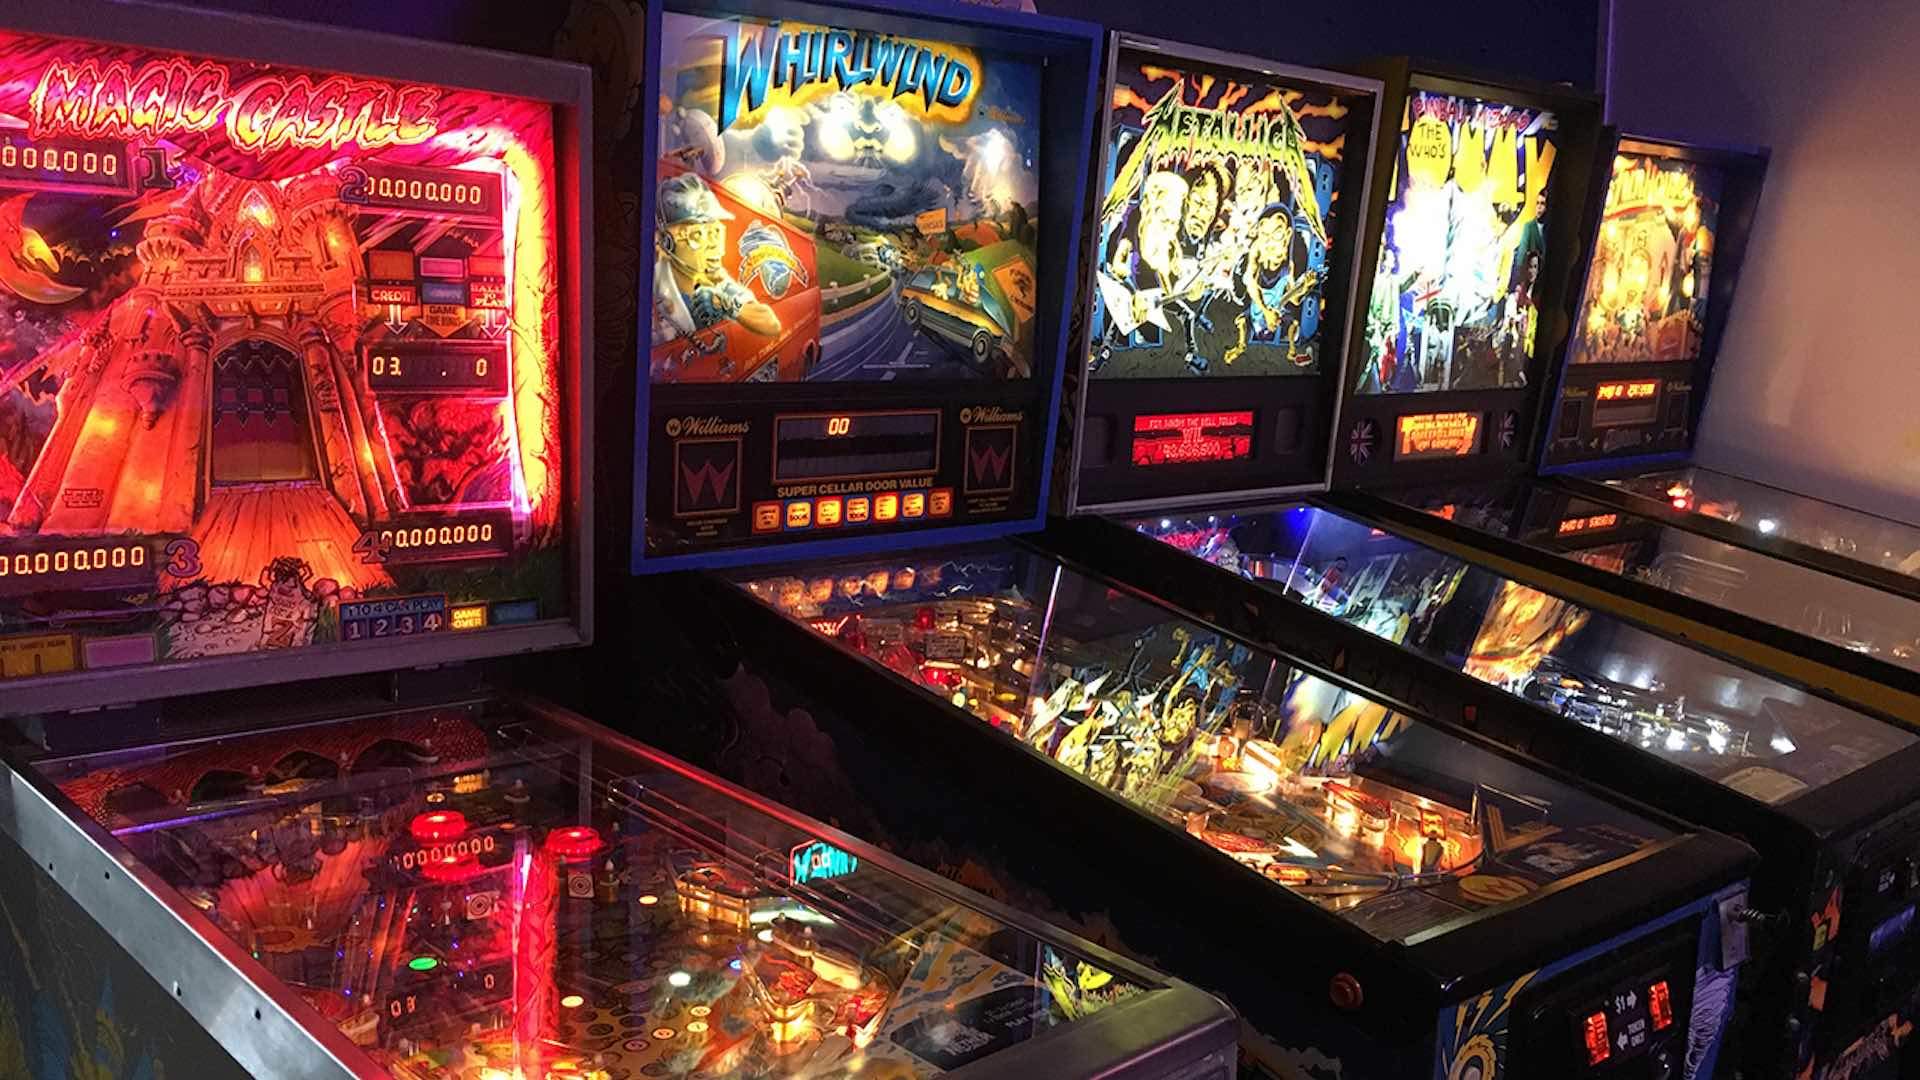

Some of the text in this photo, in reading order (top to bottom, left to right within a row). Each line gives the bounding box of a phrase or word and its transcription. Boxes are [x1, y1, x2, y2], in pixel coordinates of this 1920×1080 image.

[717, 21, 973, 135] WHIRLWIND
[28, 57, 441, 152] MAGIC CASTLE
[1419, 122, 1443, 141] THE
[1408, 142, 1447, 159] WHO'S
[338, 165, 369, 205] 2
[475, 358, 488, 377] 0
[974, 405, 1023, 423] Williams
[683, 415, 751, 436] Williams
[828, 417, 850, 436] 00
[777, 477, 934, 498] SUPER CELLAR DOOR VALUE
[352, 530, 388, 564] 4
[166, 538, 203, 578] 3
[453, 608, 481, 619] GAME
[453, 617, 482, 629] OVER
